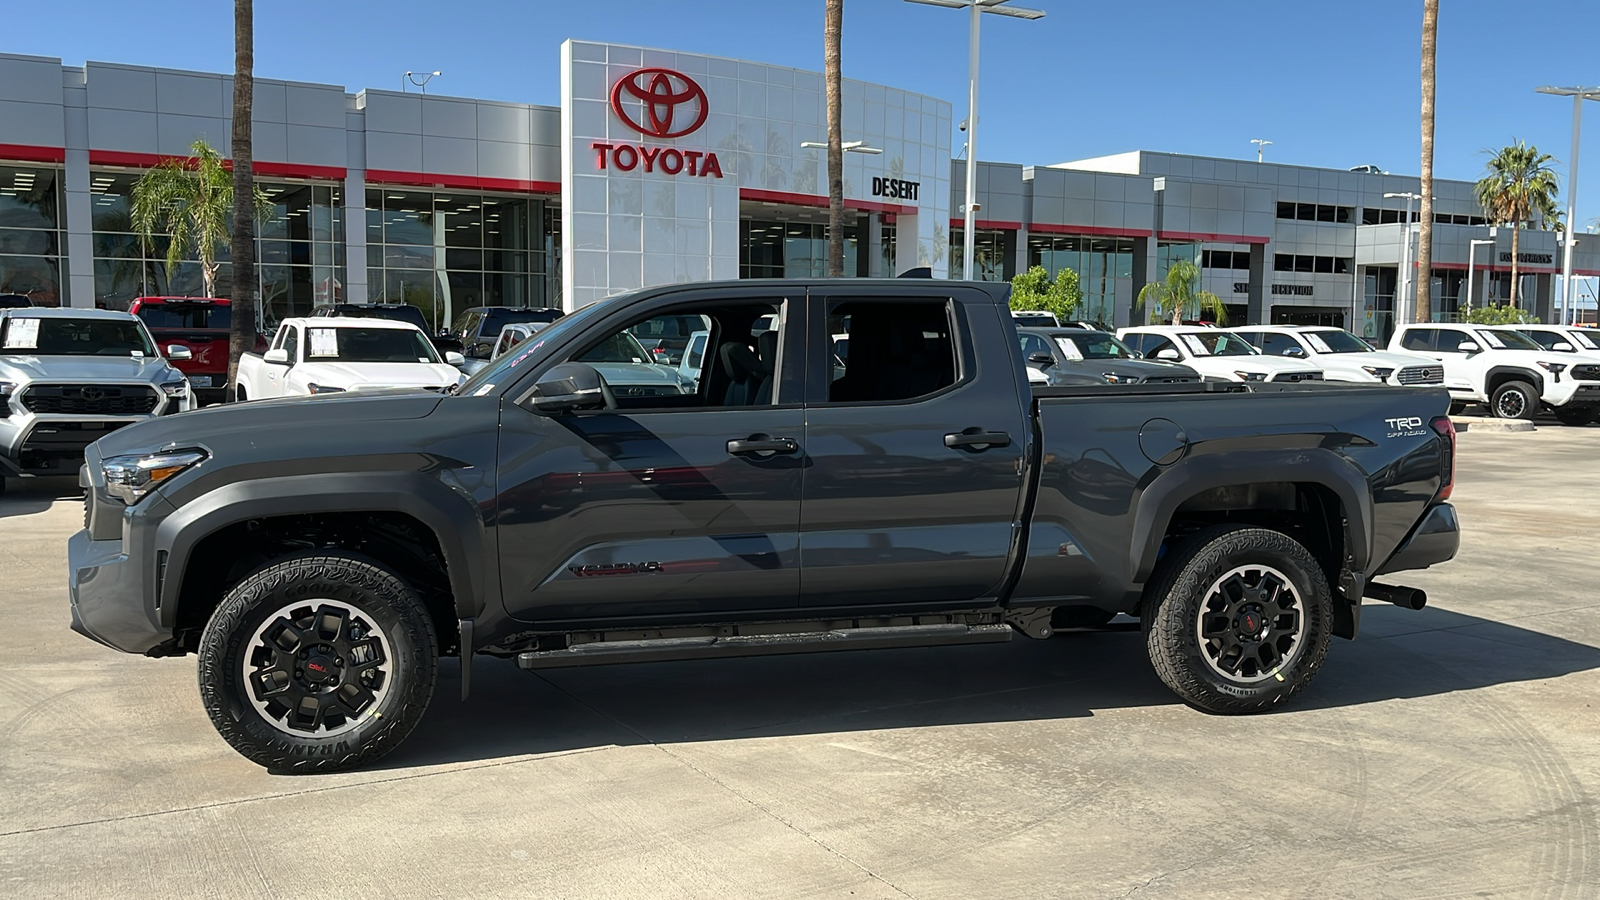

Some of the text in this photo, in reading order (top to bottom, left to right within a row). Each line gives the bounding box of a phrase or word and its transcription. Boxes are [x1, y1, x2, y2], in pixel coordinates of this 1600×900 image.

[592, 143, 723, 178] TOYOTA
[872, 176, 920, 200] DESERT
[1384, 416, 1422, 431] TRD
